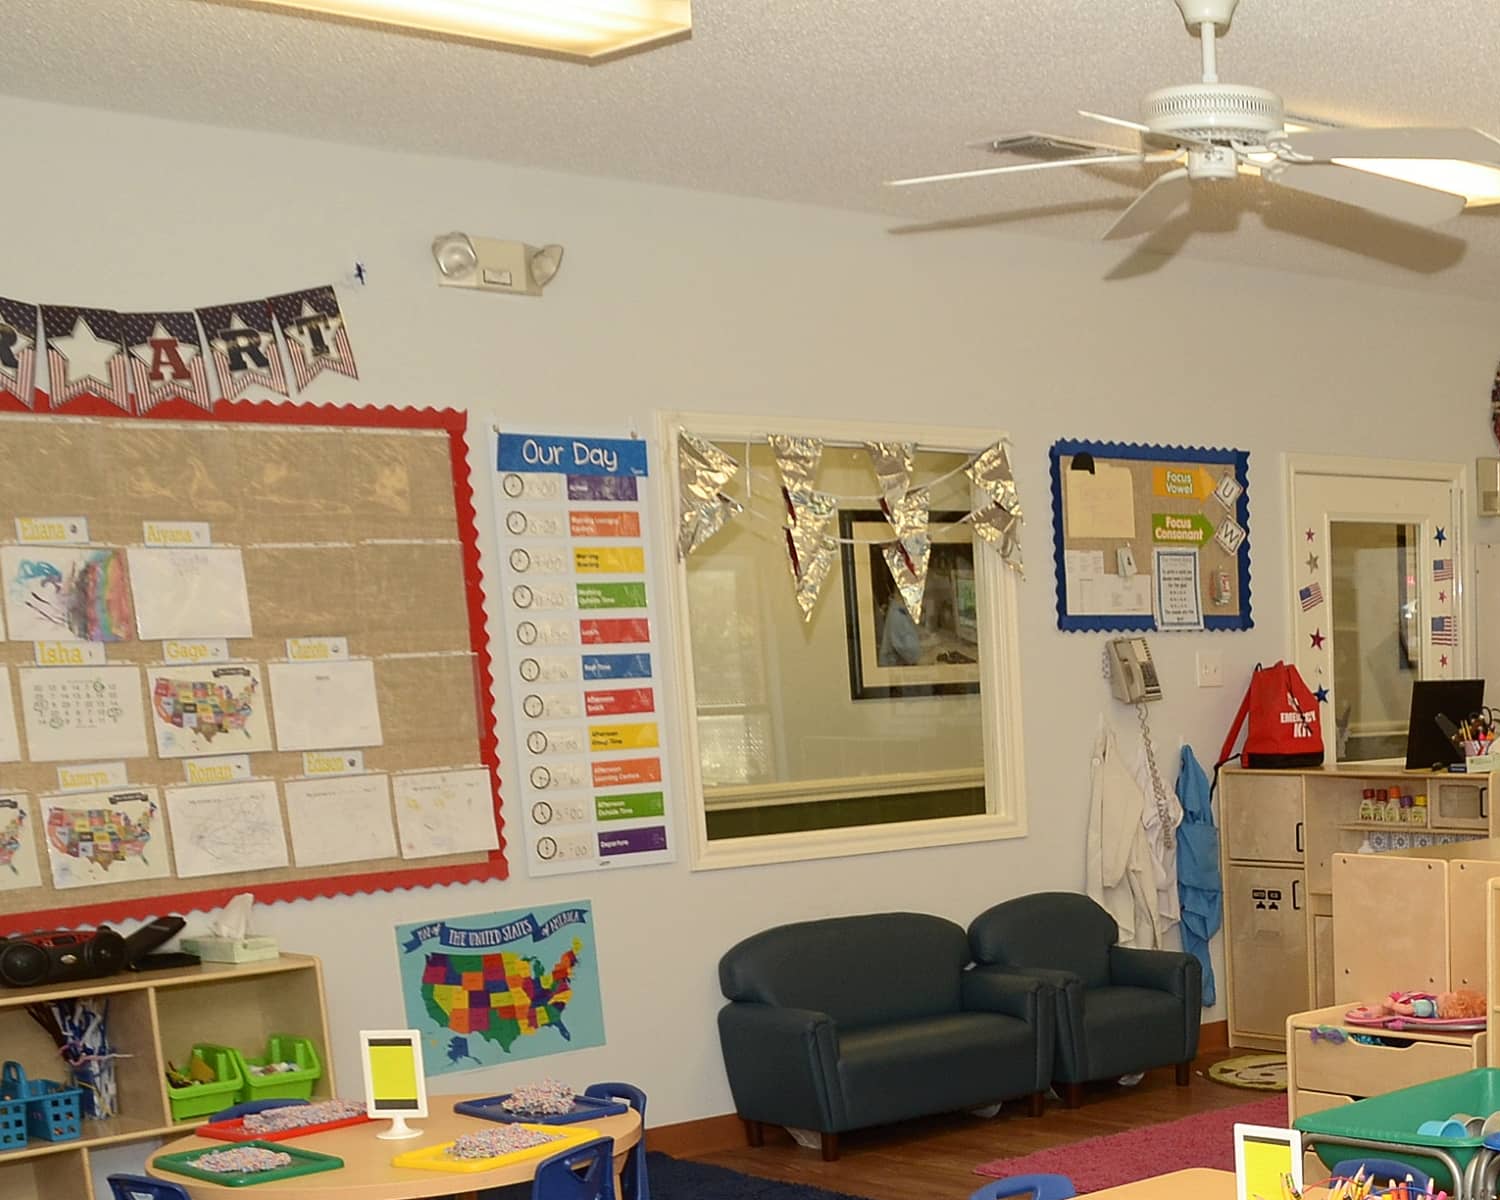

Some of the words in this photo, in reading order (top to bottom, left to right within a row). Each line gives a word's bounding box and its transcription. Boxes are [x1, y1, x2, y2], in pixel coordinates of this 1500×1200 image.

[522, 439, 565, 465] Our
[572, 441, 619, 472] Day
[1166, 471, 1193, 484] Focus
[1166, 482, 1194, 495] Vowel
[1222, 481, 1234, 498] U
[1166, 516, 1192, 529] Focus
[1223, 521, 1239, 545] W
[1155, 527, 1204, 541] Consonant
[38, 641, 84, 665] Isha
[165, 642, 209, 663] Gage
[187, 762, 234, 784] Roman
[448, 929, 466, 946] THE
[468, 927, 502, 947] UNITED
[503, 919, 533, 941] STATES
[549, 910, 579, 932] AMERICA
